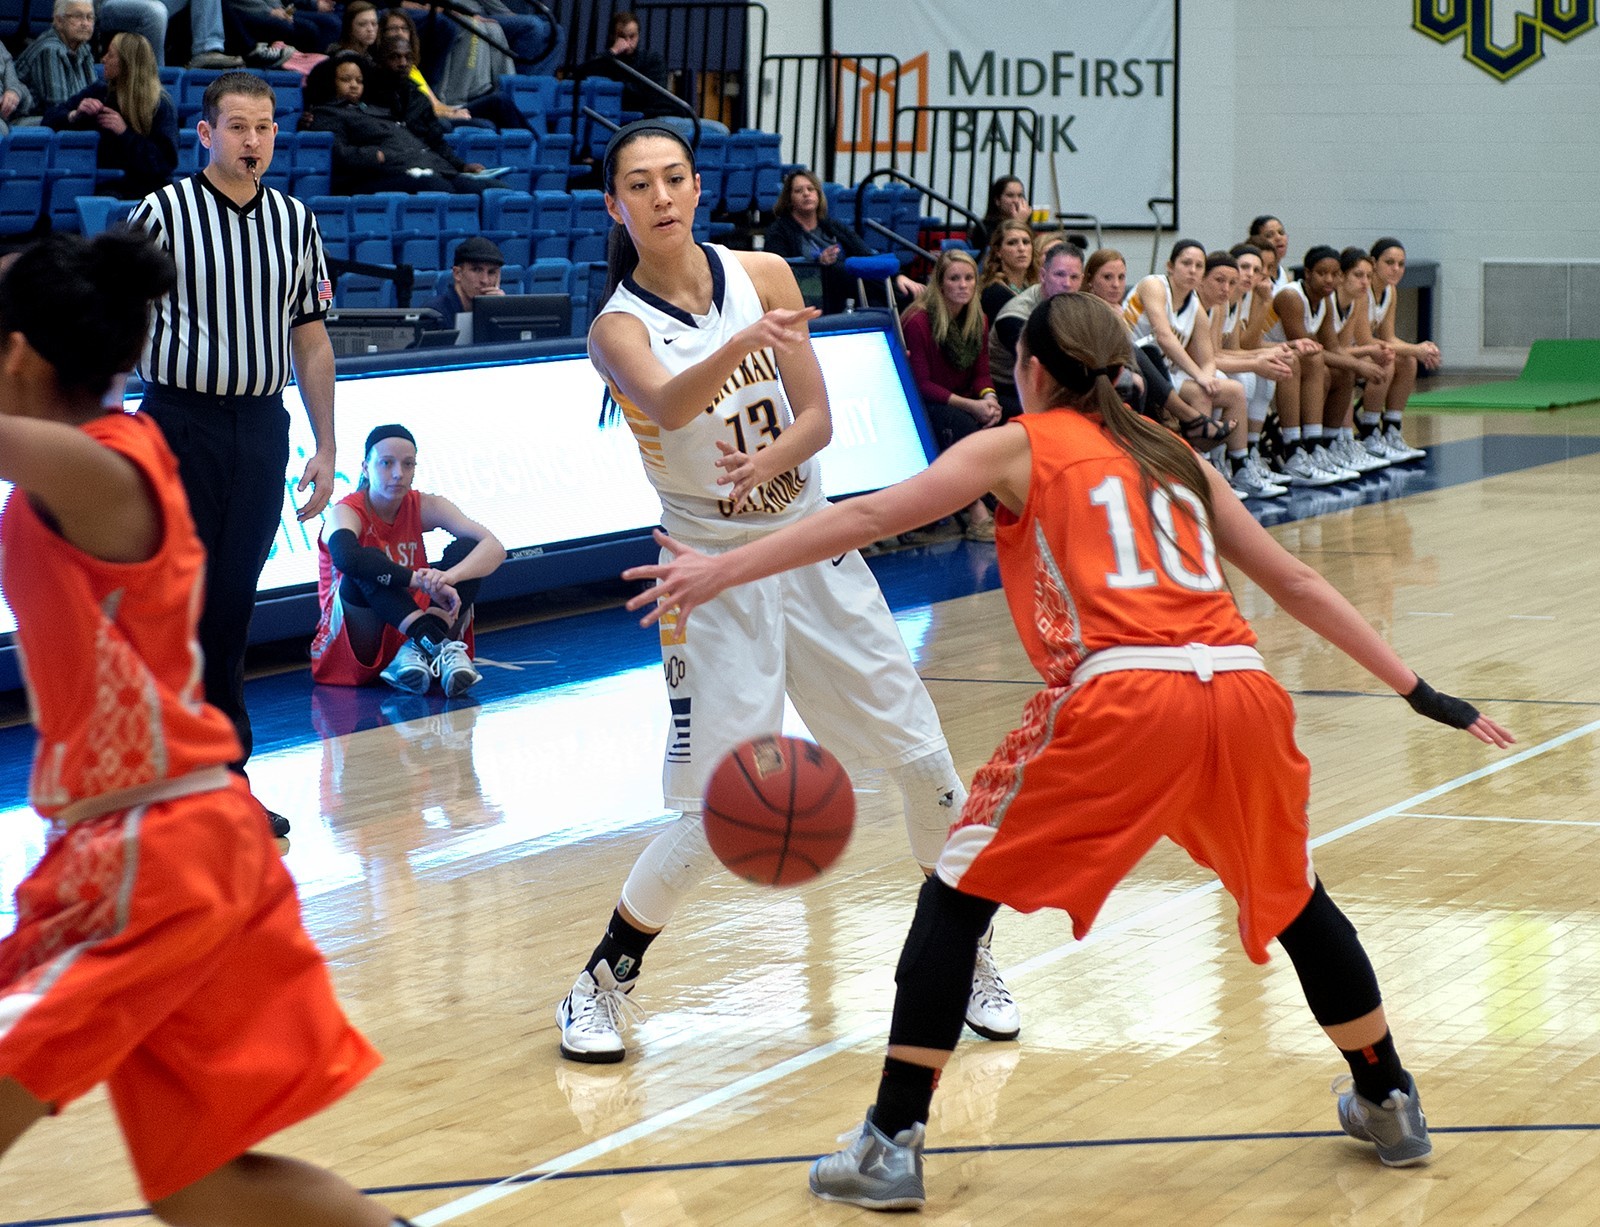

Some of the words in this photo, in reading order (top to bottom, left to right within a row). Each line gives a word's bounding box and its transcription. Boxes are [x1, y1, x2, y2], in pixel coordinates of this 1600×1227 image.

[949, 112, 1078, 152] BANK
[724, 397, 782, 454] 13
[1089, 475, 1225, 592] 10
